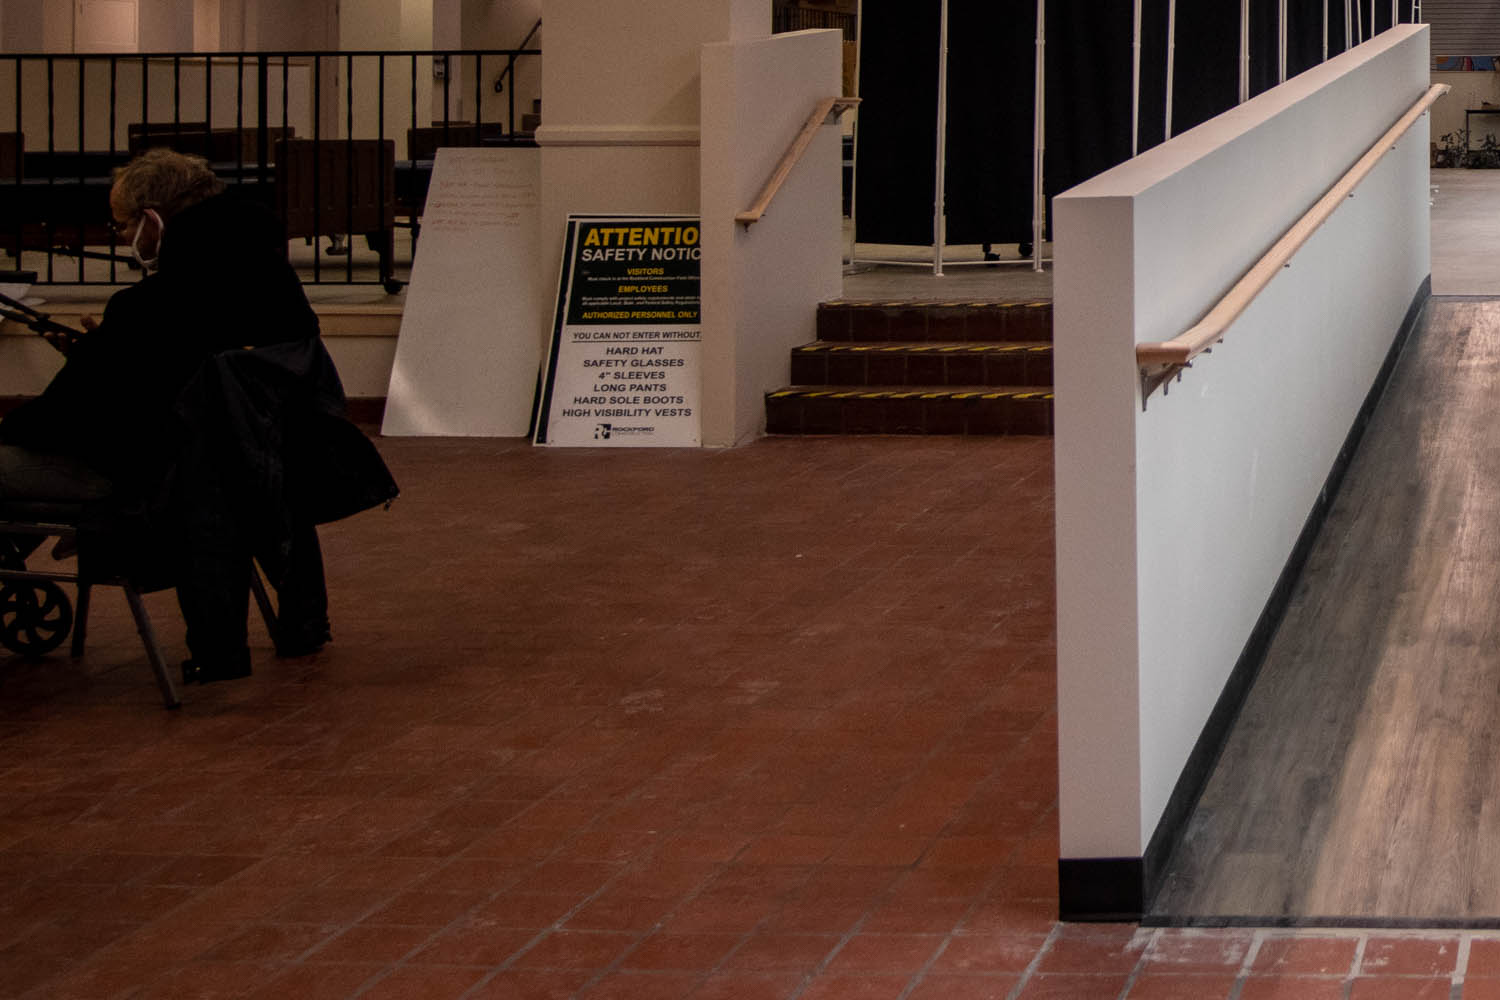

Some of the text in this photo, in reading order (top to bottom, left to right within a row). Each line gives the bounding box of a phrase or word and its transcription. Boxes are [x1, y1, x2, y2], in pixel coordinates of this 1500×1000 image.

[581, 247, 648, 262] SAFETY
[626, 267, 665, 275] VISITORS
[617, 285, 668, 293] EMPLOYEES
[581, 311, 698, 319] AUTHORIZED PERSONNEL ONLY
[632, 331, 660, 339] ENTER
[606, 346, 664, 355] HARD HAT
[583, 358, 685, 368] SAFETY GLASSES
[613, 371, 666, 380] SLEEVES
[593, 384, 667, 392] LONG PANTS
[573, 396, 684, 405] HARD SOLE BOOTS
[562, 408, 692, 417] HIGH VISIBILITY VESTS
